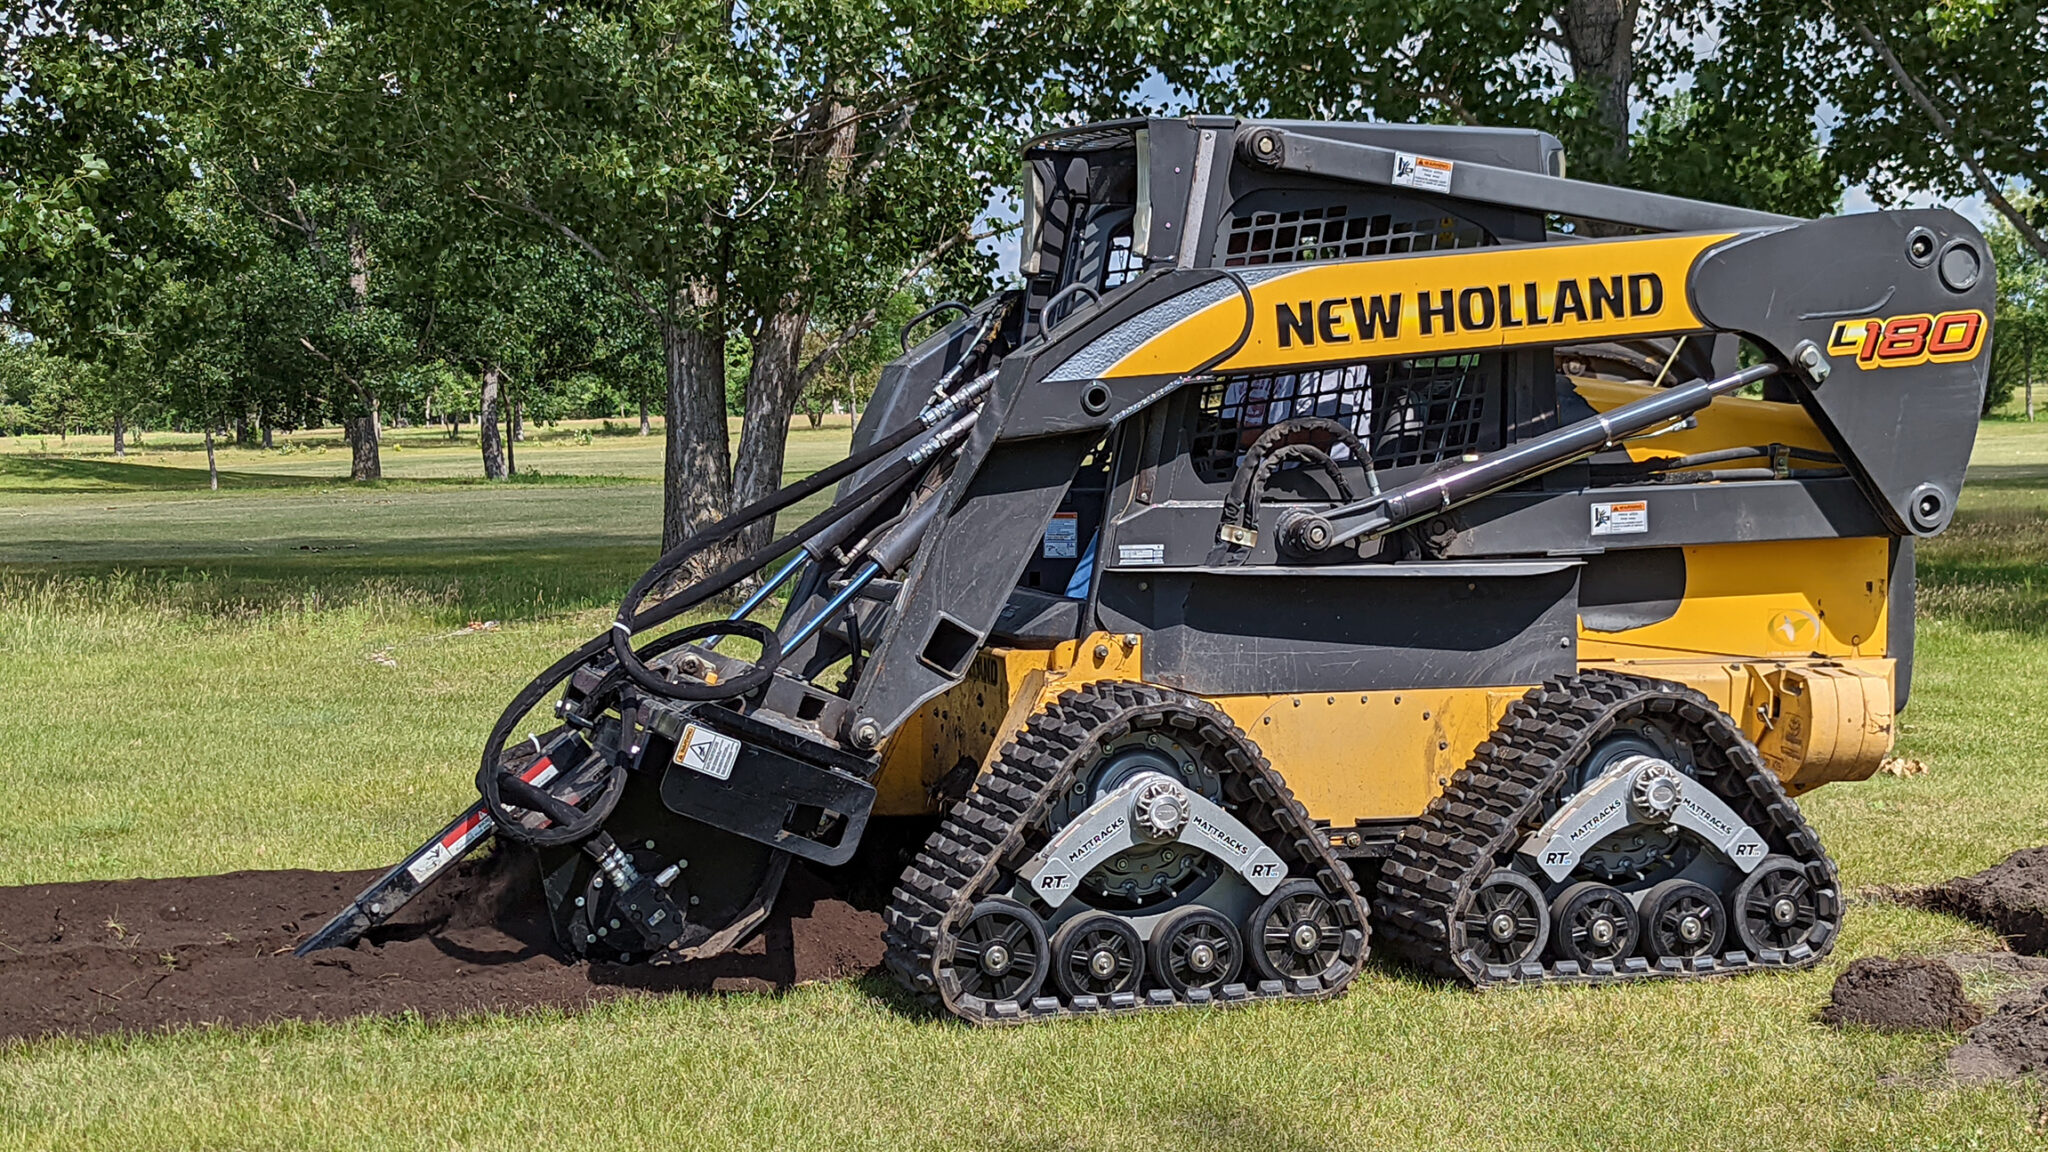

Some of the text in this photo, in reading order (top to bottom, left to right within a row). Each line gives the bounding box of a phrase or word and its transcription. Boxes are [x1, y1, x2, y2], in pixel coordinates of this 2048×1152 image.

[1275, 272, 1664, 348] NEW HOLLAND
[1830, 312, 1983, 364] L180
[1570, 799, 1621, 841] MATTRACKS
[1683, 798, 1732, 834] MATTRACKS
[1069, 817, 1125, 862] MATTRACKS
[1193, 816, 1248, 855] MATTRACKS
[1736, 844, 1759, 856] RT
[1252, 864, 1278, 877] RT
[1546, 851, 1570, 865] RT
[1041, 875, 1068, 889] RT
